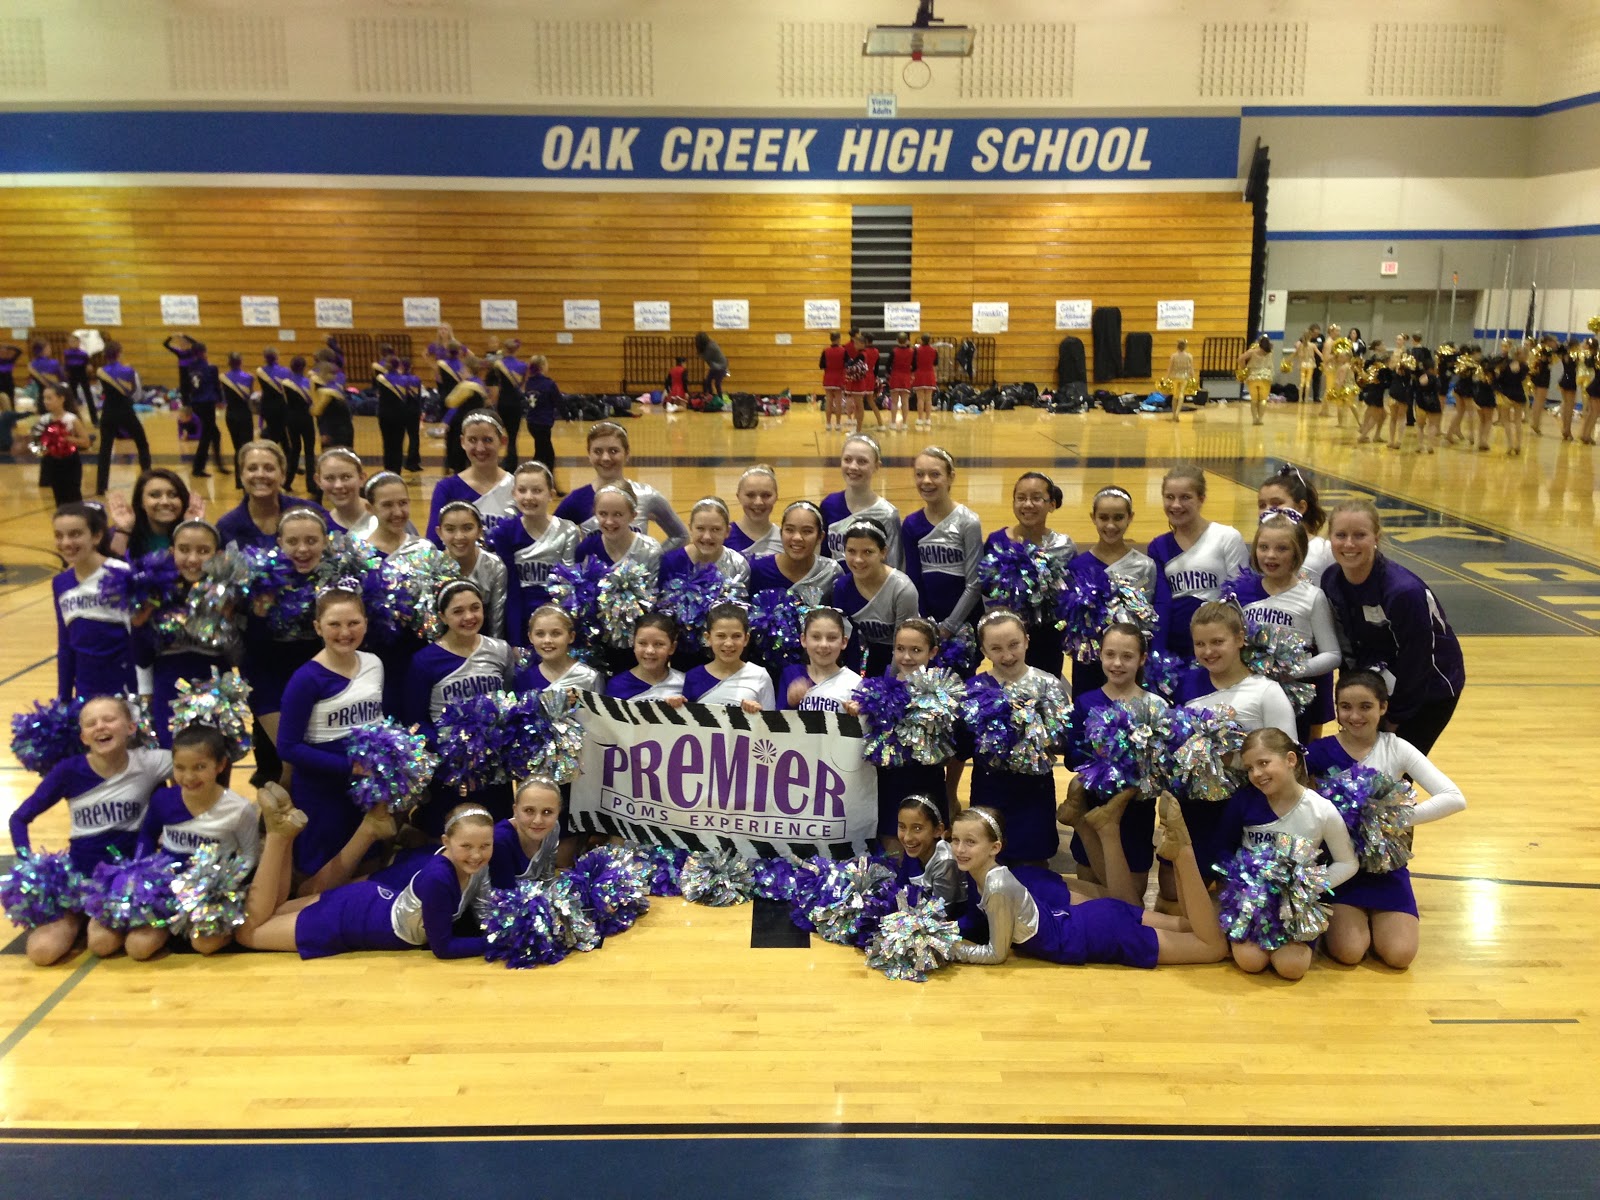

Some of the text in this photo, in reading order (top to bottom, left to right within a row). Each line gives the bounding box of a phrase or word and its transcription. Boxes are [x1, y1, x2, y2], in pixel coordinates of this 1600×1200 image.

[541, 125, 1153, 173] OAK CREEK HIGH SCHOOL
[919, 544, 964, 565] ReMieR
[1168, 570, 1218, 592] ReMieR
[798, 696, 839, 712] ReMieR
[612, 796, 832, 837] POMS EXPERIENCE
